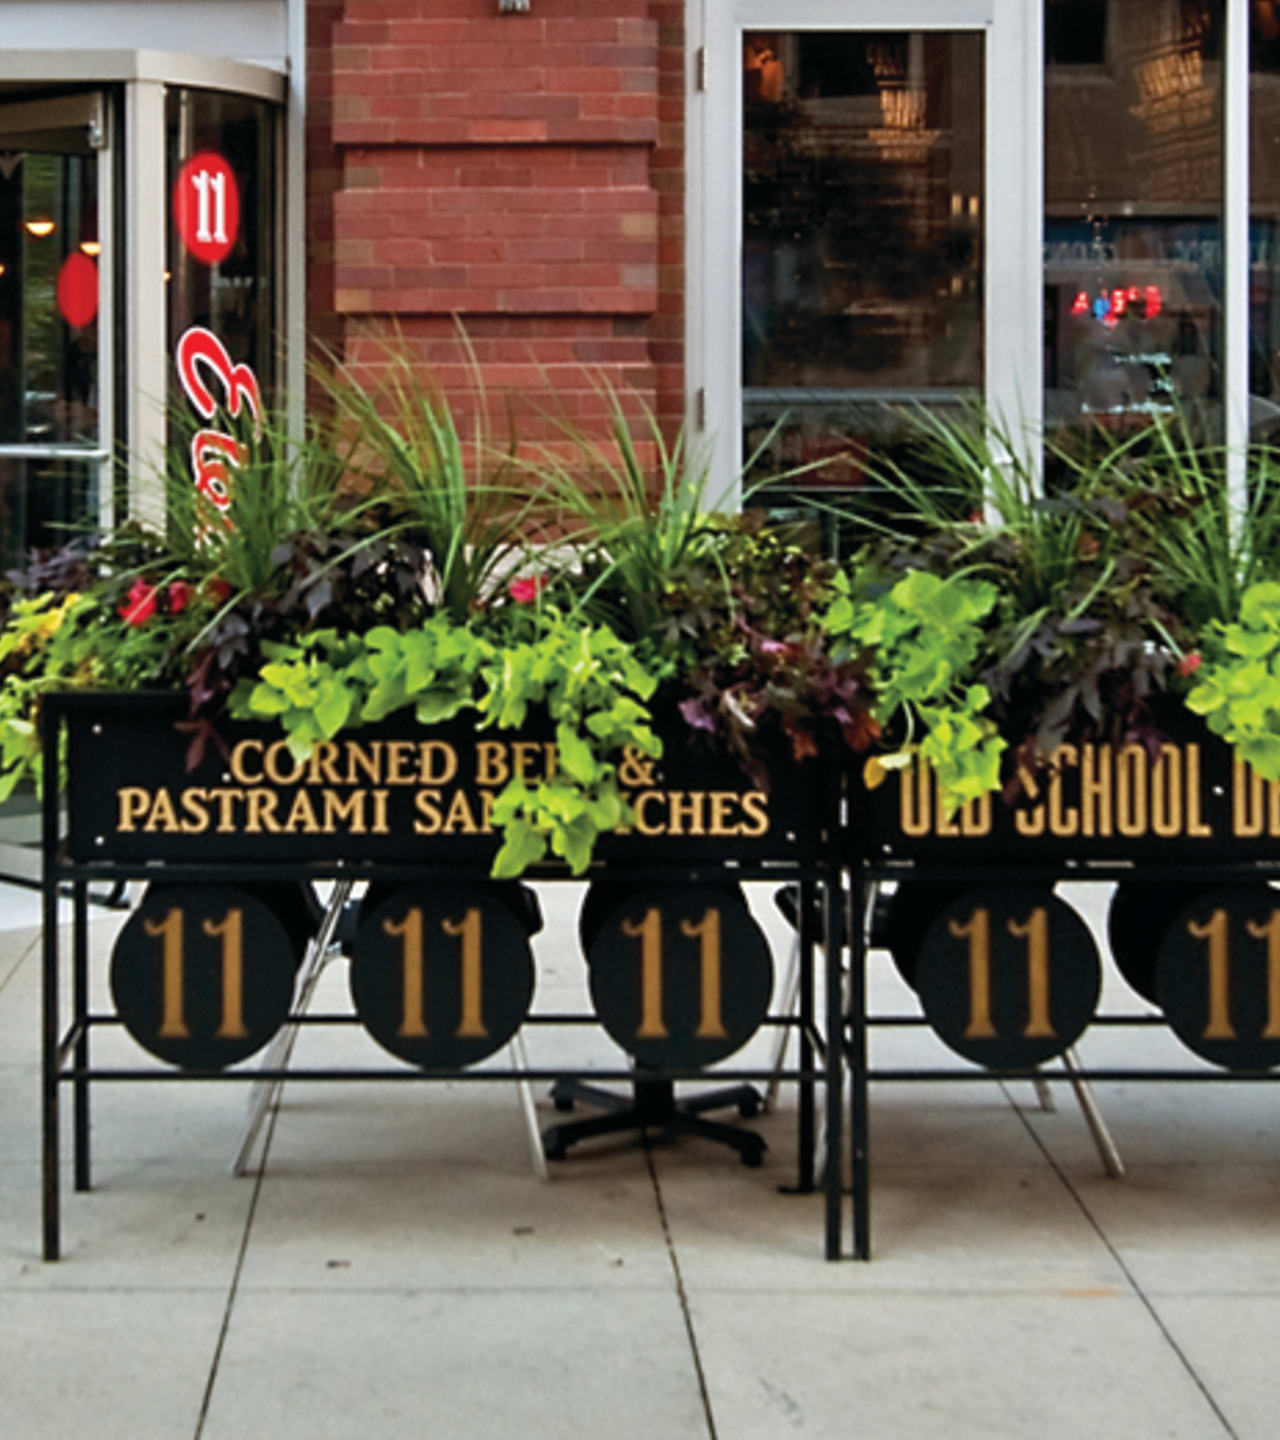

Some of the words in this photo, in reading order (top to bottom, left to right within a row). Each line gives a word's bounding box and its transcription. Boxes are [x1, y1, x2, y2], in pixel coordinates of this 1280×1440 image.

[191, 169, 229, 244] 11
[118, 788, 388, 835] PASTRAMI
[412, 788, 770, 836] SACHES
[229, 739, 458, 787] CORNED
[619, 741, 658, 788] &
[143, 905, 248, 1039] 11
[382, 906, 489, 1039] 11
[620, 906, 728, 1039] 11
[947, 906, 1058, 1040] 11
